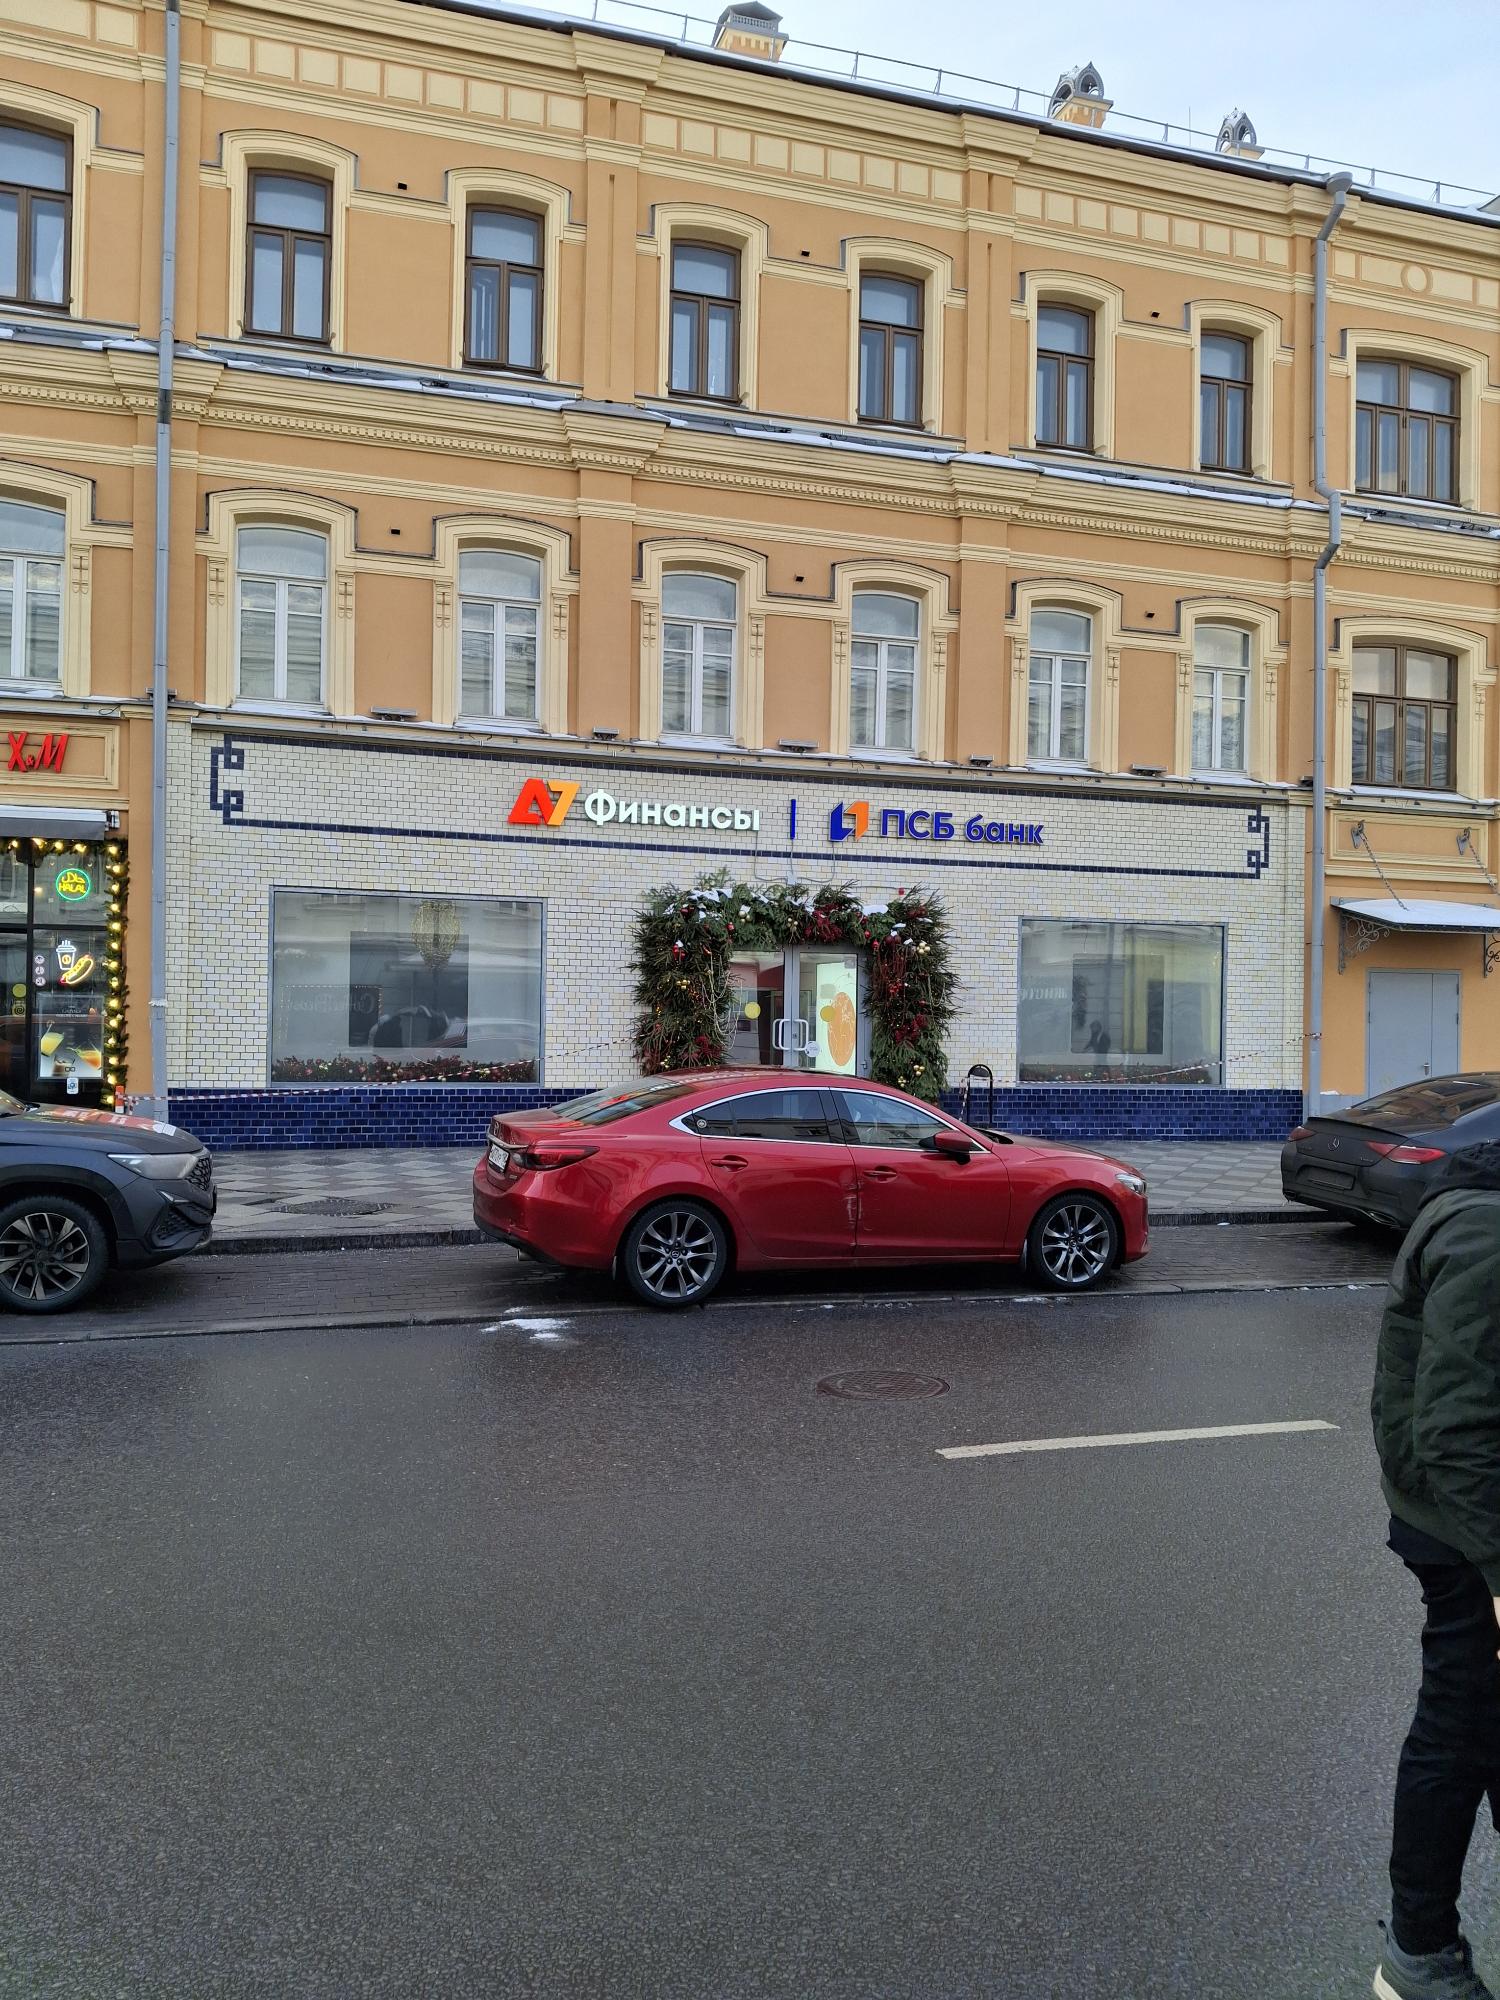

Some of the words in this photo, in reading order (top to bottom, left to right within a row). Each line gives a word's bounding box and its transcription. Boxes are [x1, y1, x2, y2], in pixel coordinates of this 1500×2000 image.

[584, 789, 760, 831] Финансы
[880, 808, 954, 840] ПСБ
[965, 813, 1045, 846] банк
[58, 882, 87, 894] HALAL
